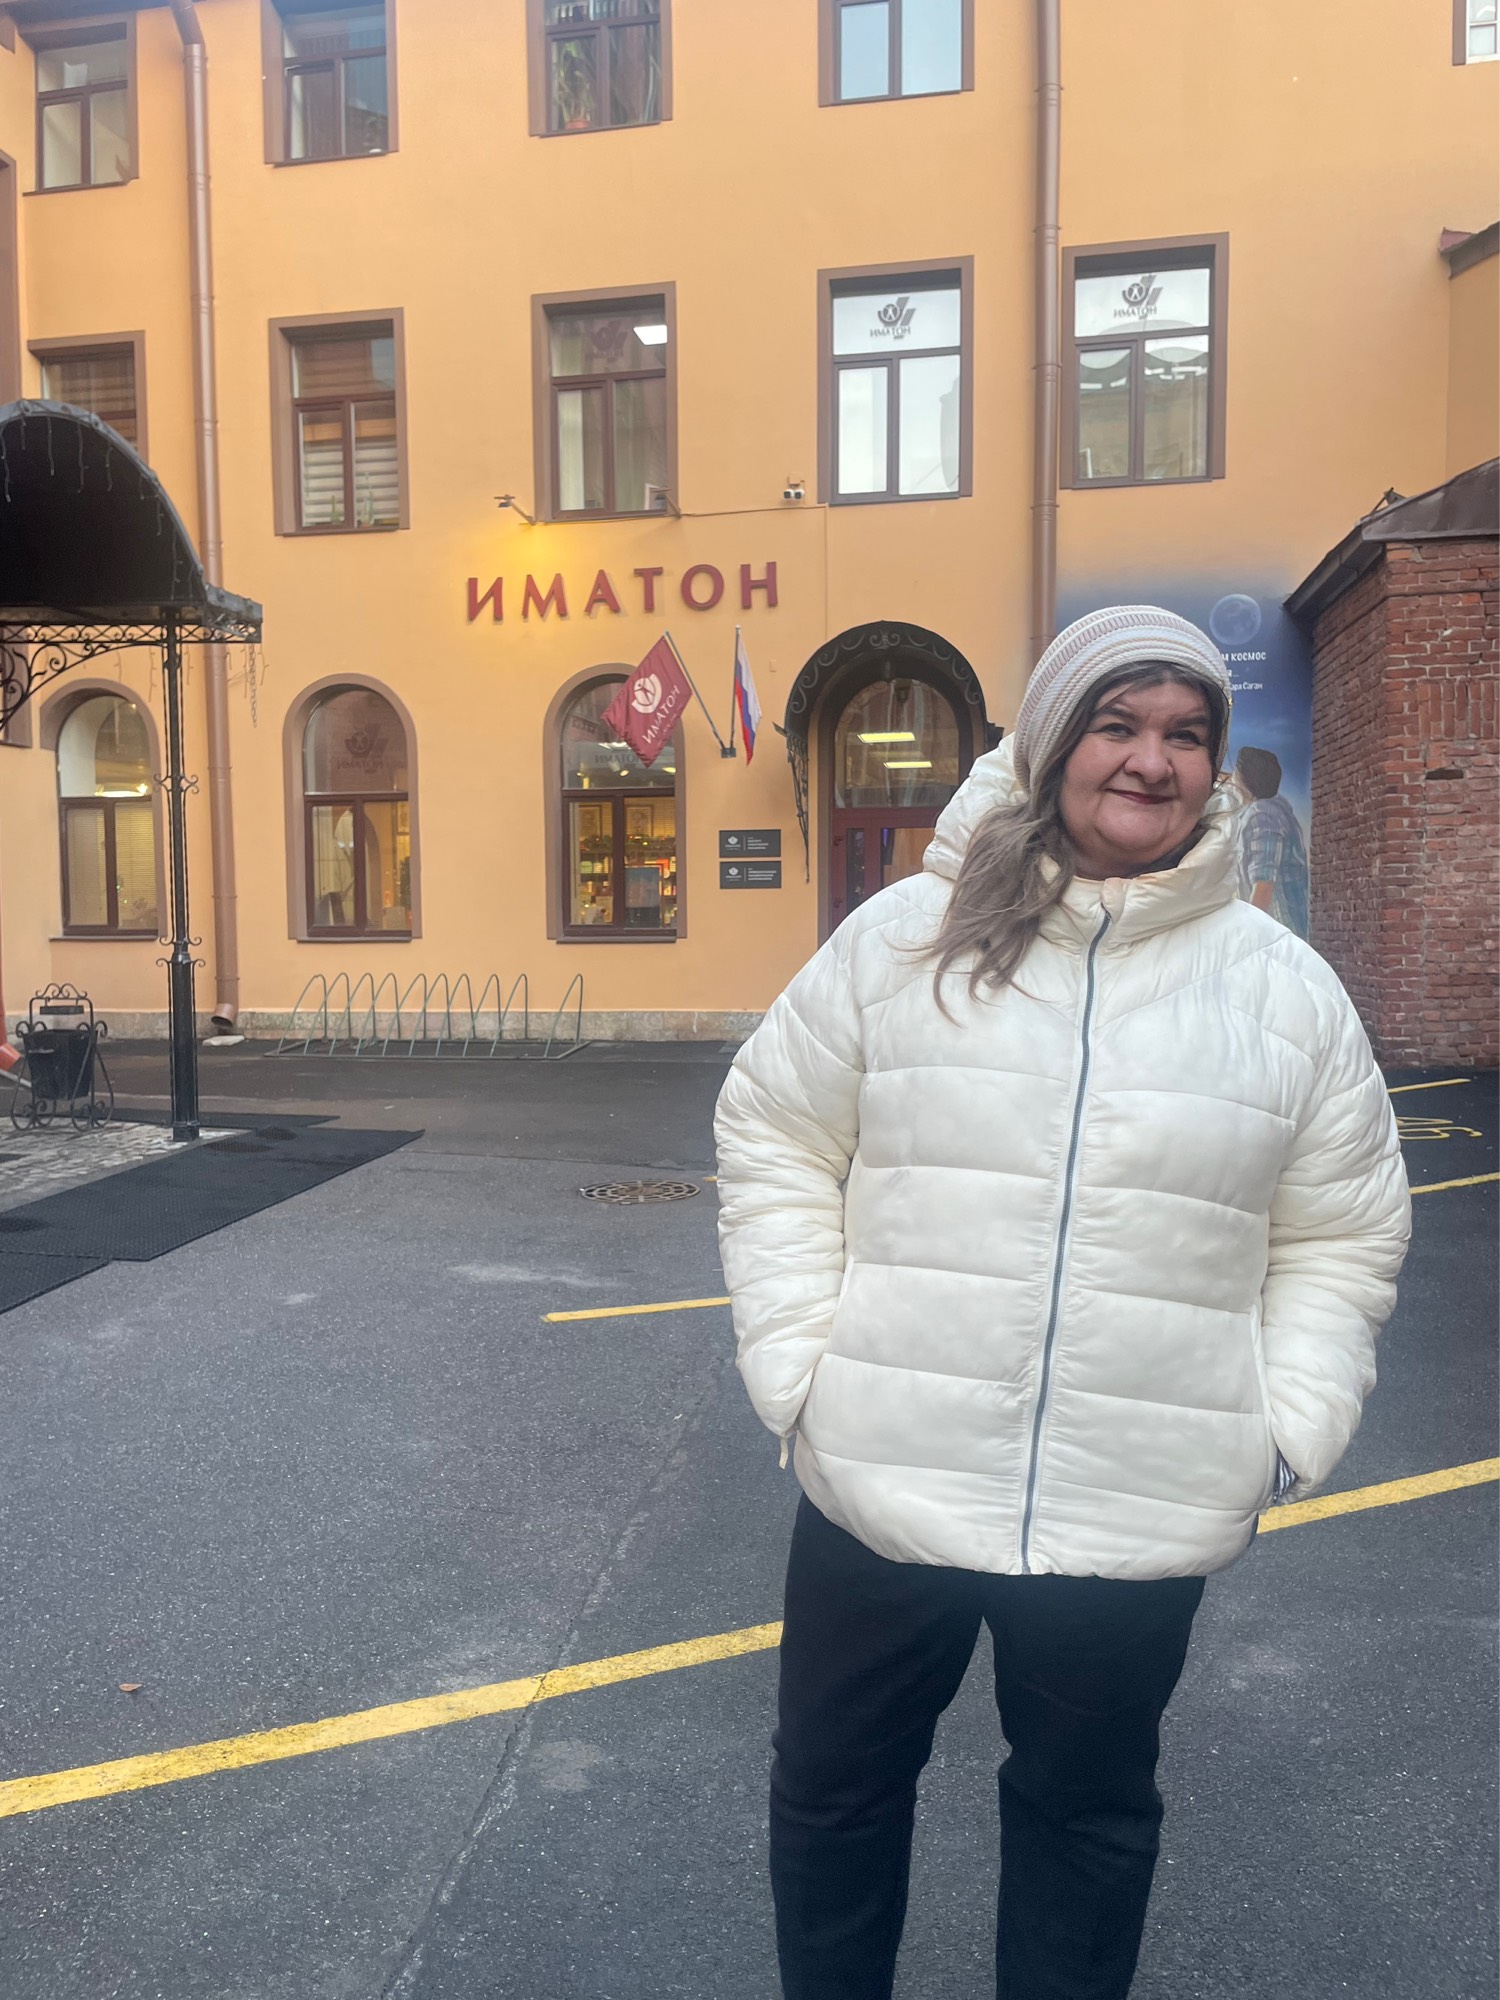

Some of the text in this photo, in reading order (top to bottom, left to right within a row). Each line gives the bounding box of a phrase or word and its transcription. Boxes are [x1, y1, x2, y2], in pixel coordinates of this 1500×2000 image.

[1113, 305, 1157, 318] ИМАТОН
[869, 325, 911, 337] ИМАТОН
[467, 561, 778, 622] ИМАТОН
[642, 684, 681, 744] ИМАТОН
